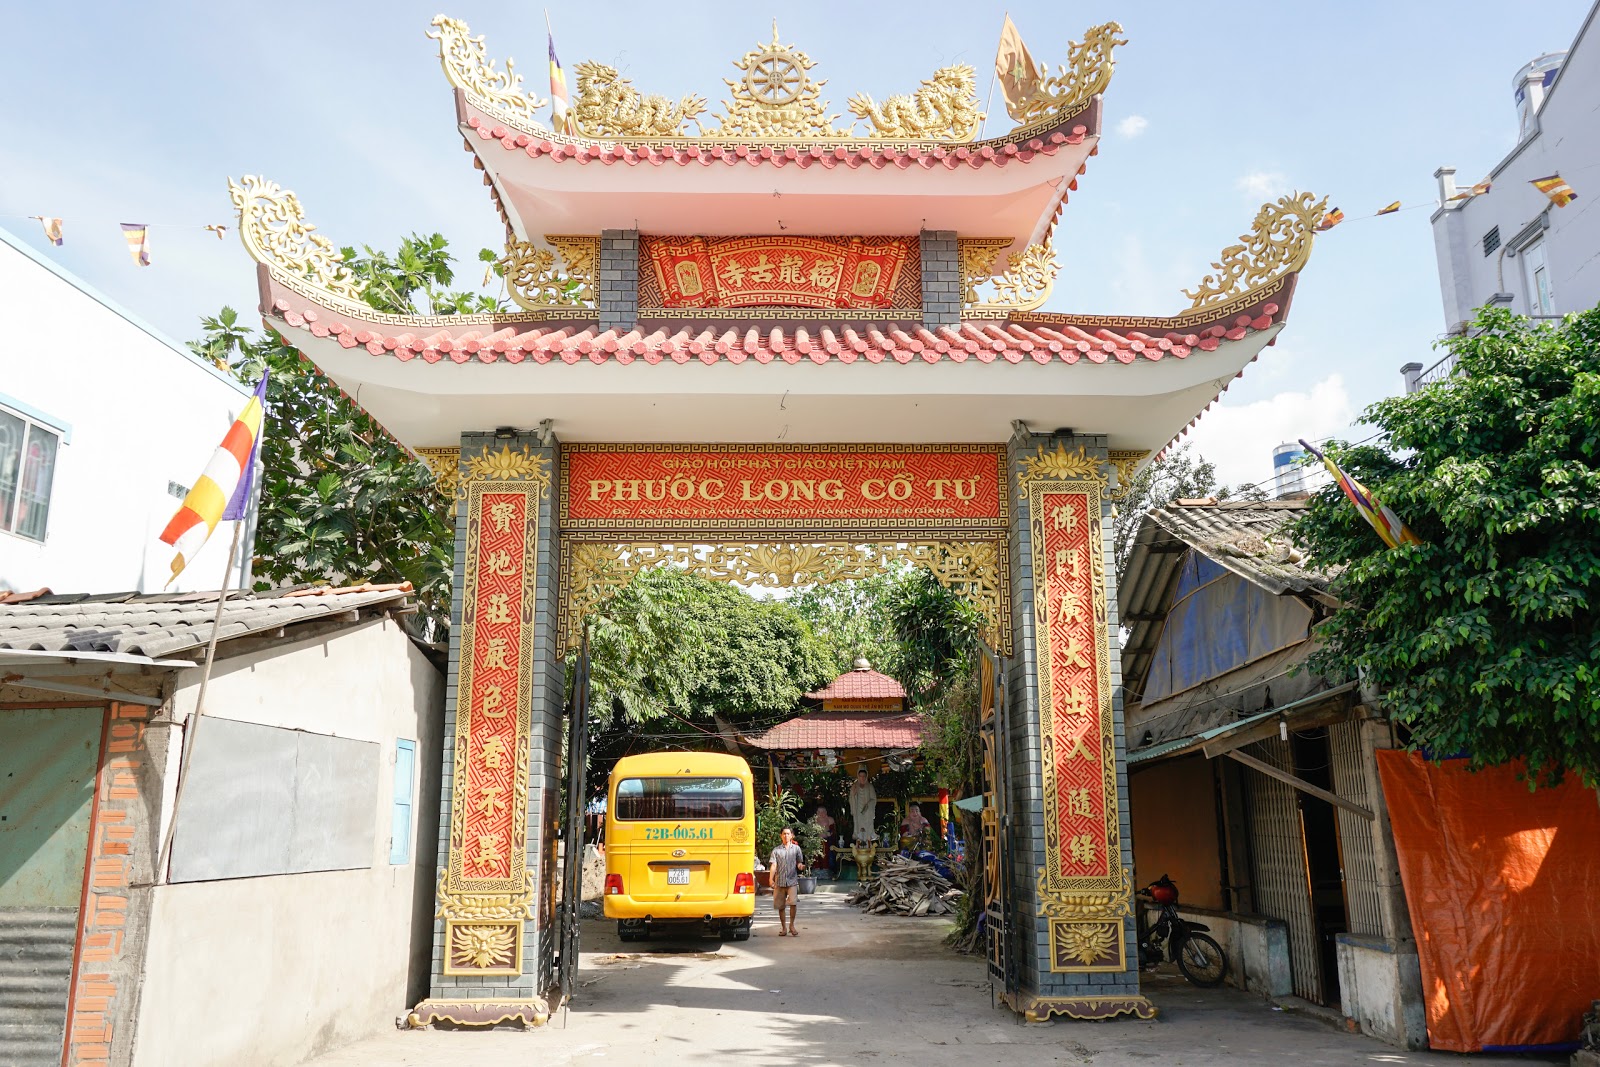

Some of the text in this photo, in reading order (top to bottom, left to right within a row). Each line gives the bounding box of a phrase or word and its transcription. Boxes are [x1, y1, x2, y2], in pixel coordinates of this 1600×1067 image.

[662, 456, 905, 471] GIÁO HỘI PHẬT GIÁO VIỆT NAM
[588, 472, 981, 506] PHƯỚC LONG CỔ TỰ
[645, 827, 714, 840] 72B-005.61
